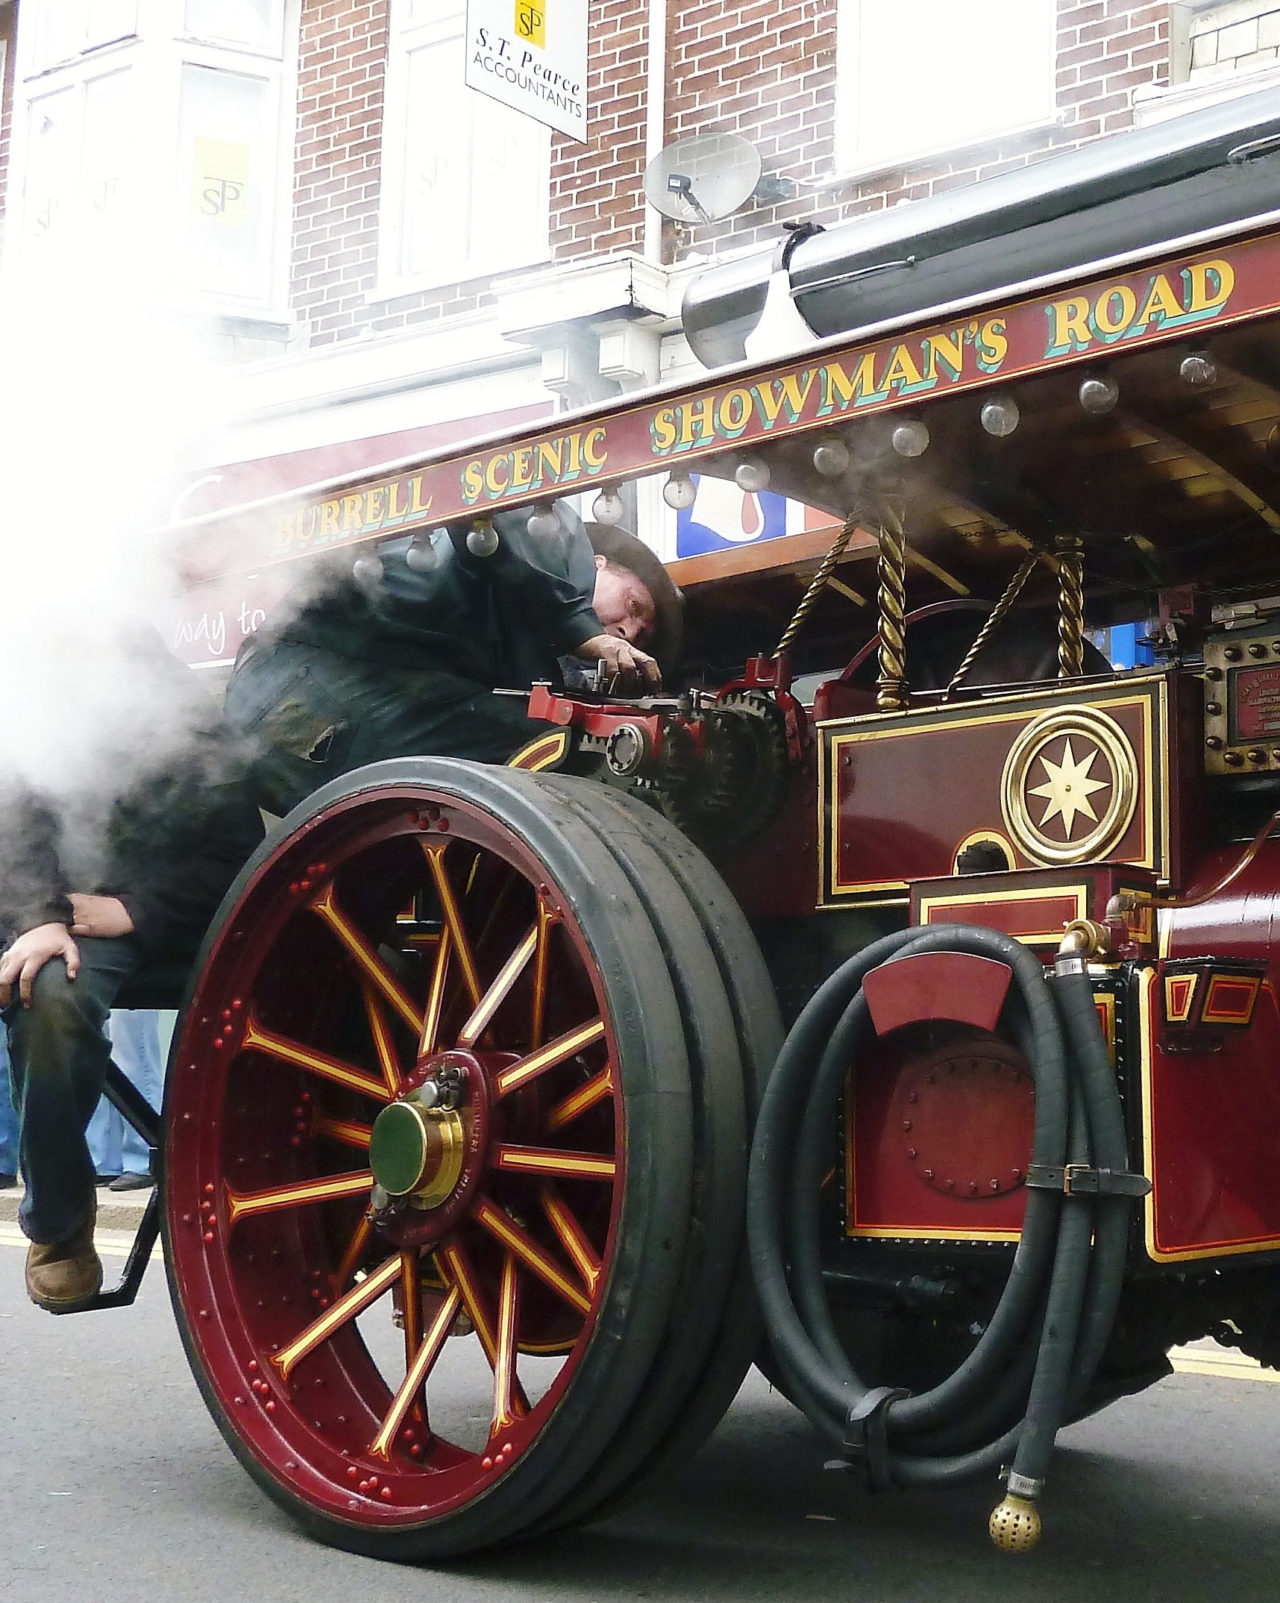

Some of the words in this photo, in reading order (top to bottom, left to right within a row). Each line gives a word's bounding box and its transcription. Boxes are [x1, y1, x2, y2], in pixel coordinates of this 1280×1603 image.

[474, 51, 582, 118] ACCOUNTANTS
[521, 51, 580, 96] Pearce
[270, 476, 433, 555] BURRELL
[461, 426, 609, 504] SCENIC
[650, 318, 1009, 455] SHOWMAN'S
[1045, 259, 1236, 359] ROAD
[174, 610, 225, 655] way
